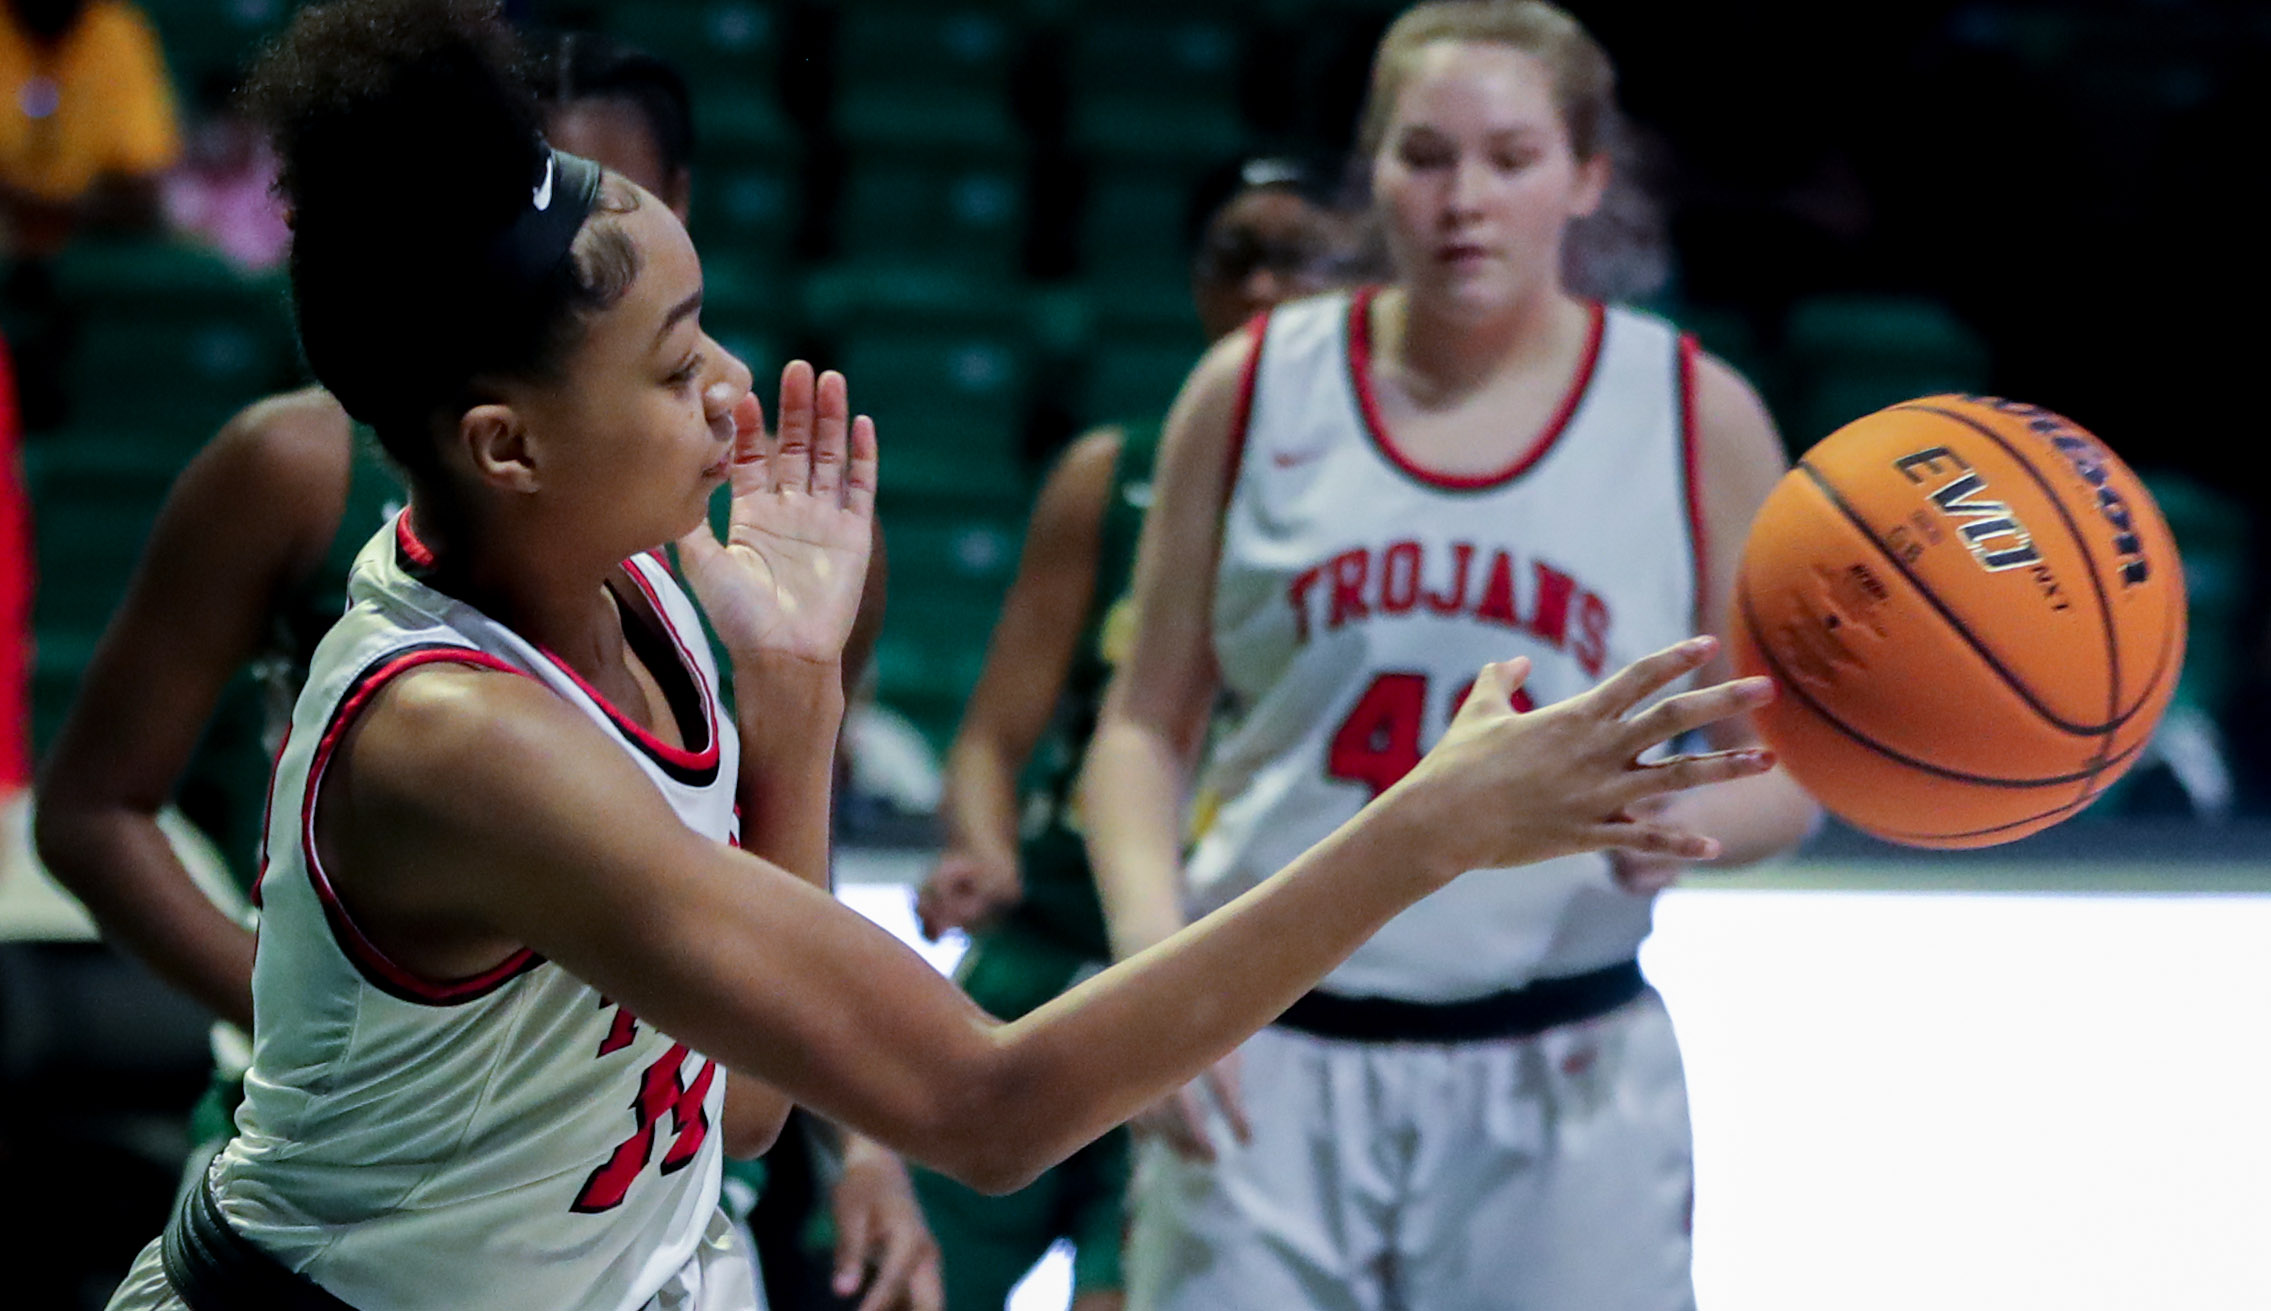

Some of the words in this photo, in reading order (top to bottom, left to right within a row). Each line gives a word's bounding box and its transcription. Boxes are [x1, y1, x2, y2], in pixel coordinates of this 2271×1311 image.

[1895, 445, 2044, 573] EVO
[2030, 563, 2070, 612] NXT
[1289, 540, 1611, 679] TROJANS
[1326, 672, 1536, 804] 4
